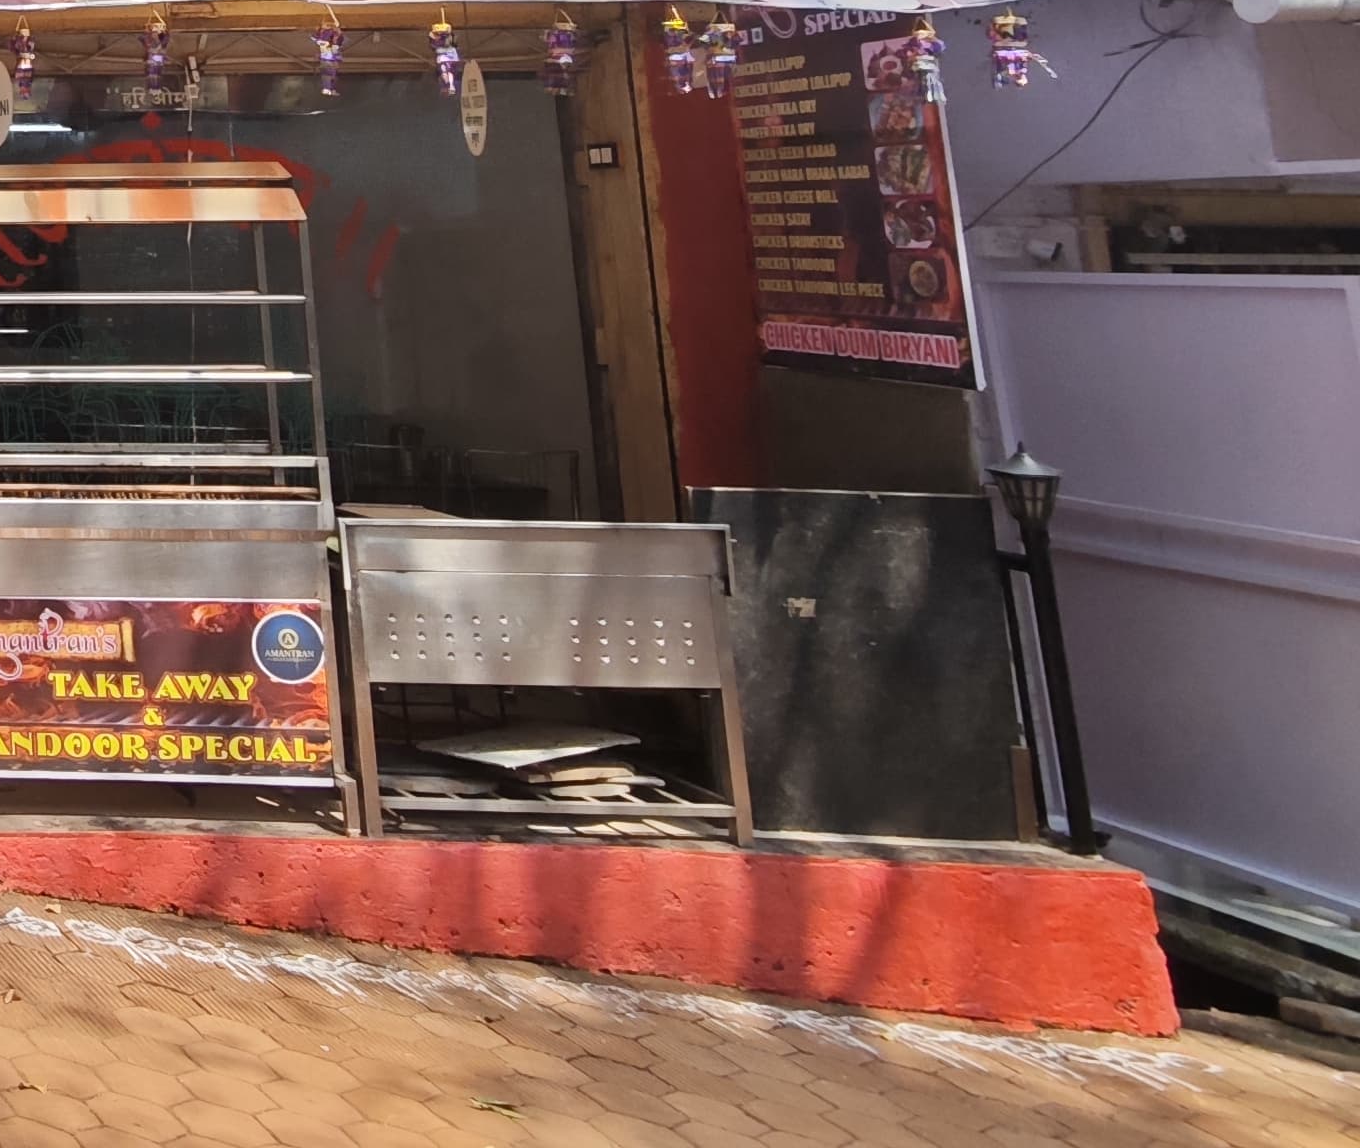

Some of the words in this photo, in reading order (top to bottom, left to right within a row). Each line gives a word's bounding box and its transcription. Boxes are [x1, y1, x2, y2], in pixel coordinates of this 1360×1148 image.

[765, 323, 834, 353] CHICKEN
[836, 328, 879, 358] DUM
[881, 333, 959, 367] BIRYANI
[264, 649, 315, 658] AMANTRAN
[48, 670, 145, 700] TAKE
[155, 672, 256, 702] AWAY
[143, 707, 165, 727] &
[158, 734, 318, 764] SPECIAL
